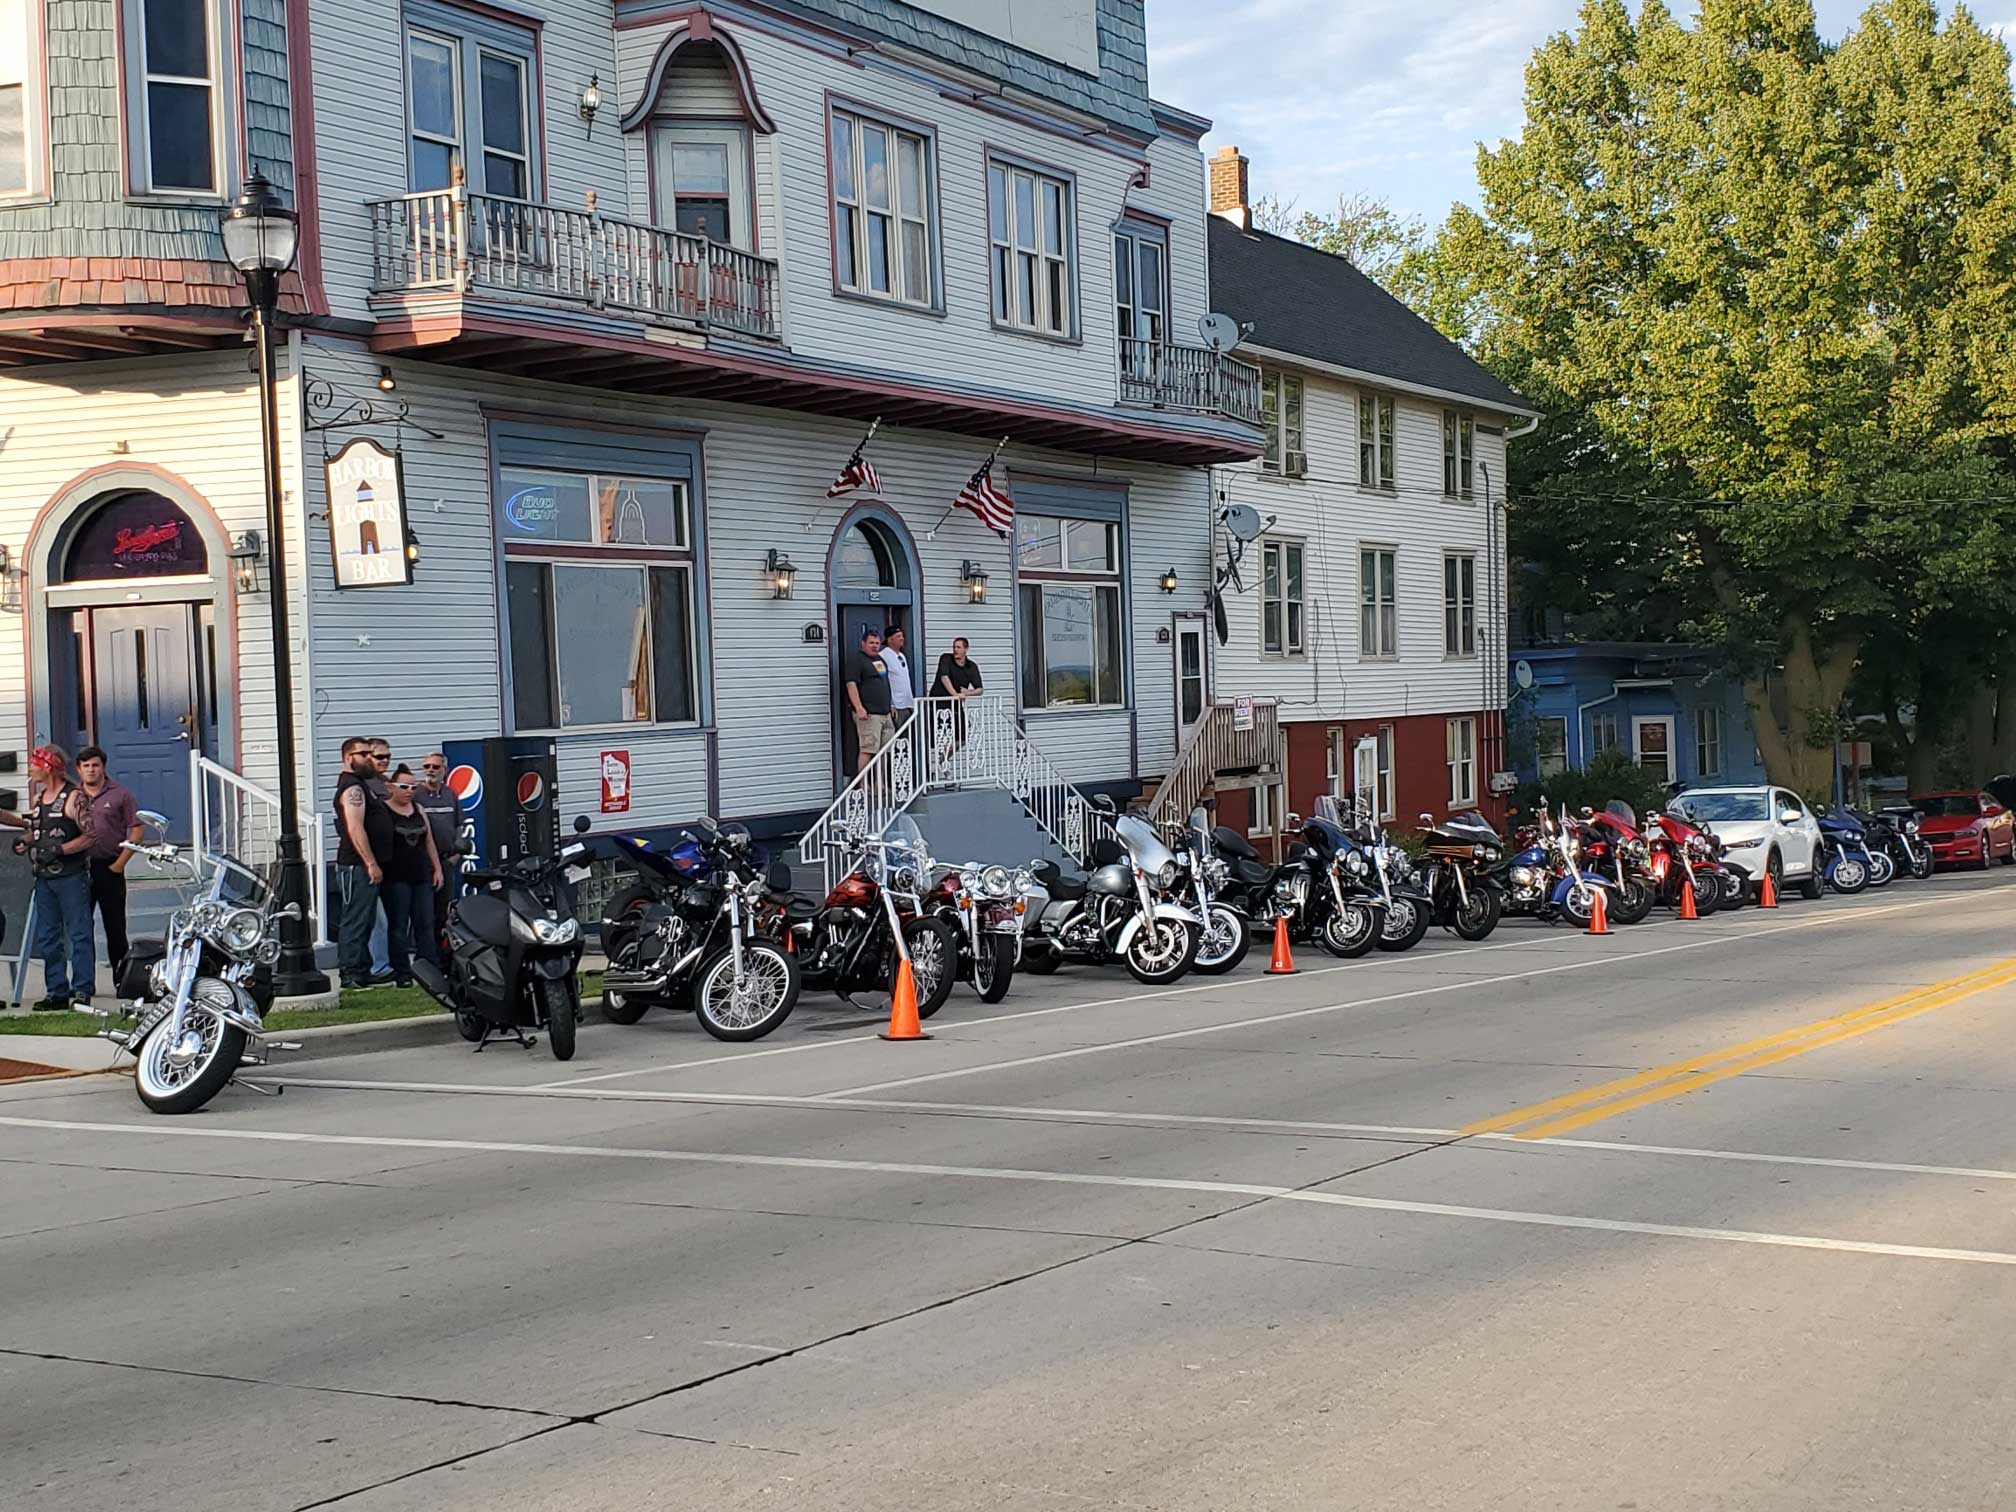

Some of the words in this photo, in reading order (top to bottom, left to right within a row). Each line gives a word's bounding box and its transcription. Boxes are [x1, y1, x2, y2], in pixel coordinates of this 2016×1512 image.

[333, 499, 398, 525] LIGHTS
[351, 557, 392, 581] BAR
[516, 813, 530, 854] pepsi
